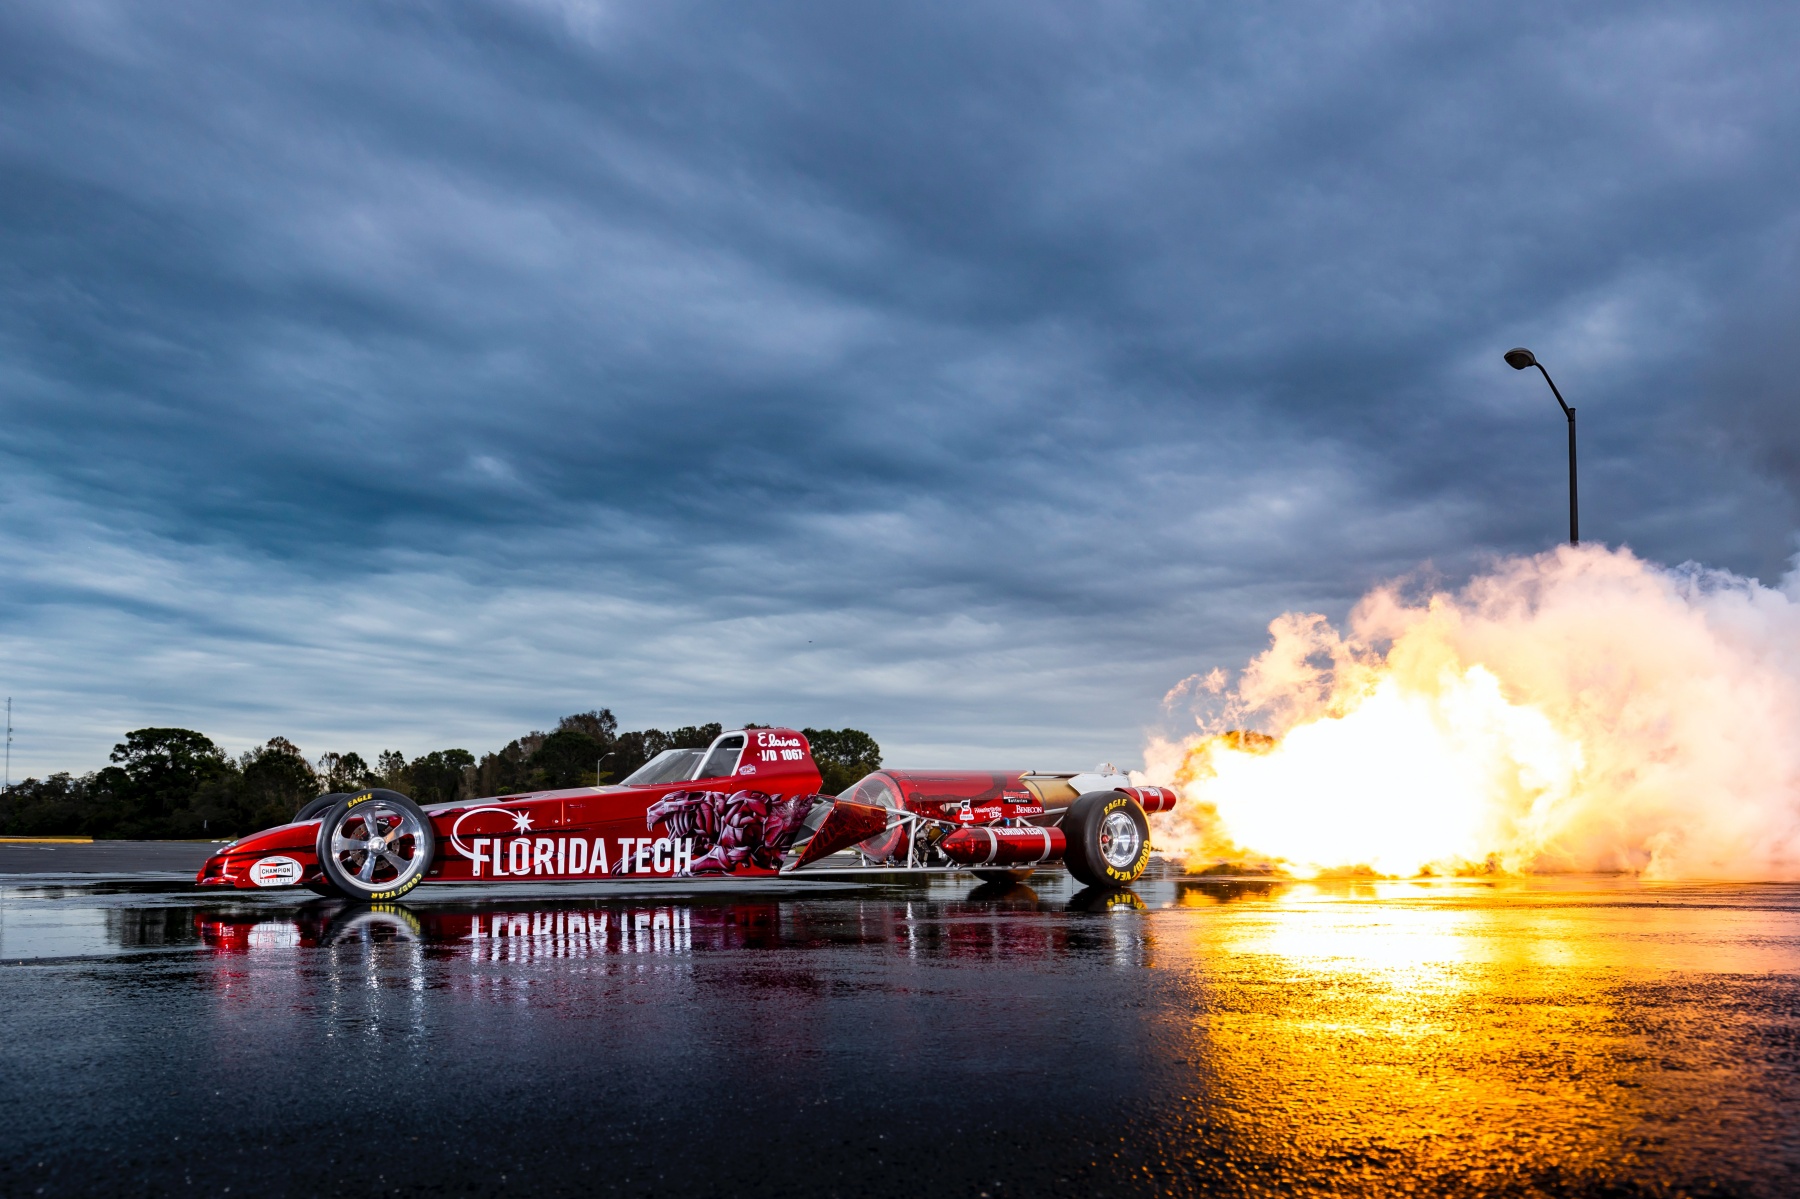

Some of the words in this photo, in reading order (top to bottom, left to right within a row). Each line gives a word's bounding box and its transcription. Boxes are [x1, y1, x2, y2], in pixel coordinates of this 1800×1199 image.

[757, 732, 800, 747] Elaine
[780, 749, 803, 761] 1067
[347, 792, 373, 808] EAGLE
[1103, 798, 1128, 815] EAGLE
[1015, 804, 1042, 814] BENECON
[996, 827, 1025, 836] FLORIDA
[1024, 827, 1043, 835] TECH
[472, 837, 609, 876] FLORIDA
[617, 837, 692, 874] TECH
[261, 867, 291, 875] CHAMPION
